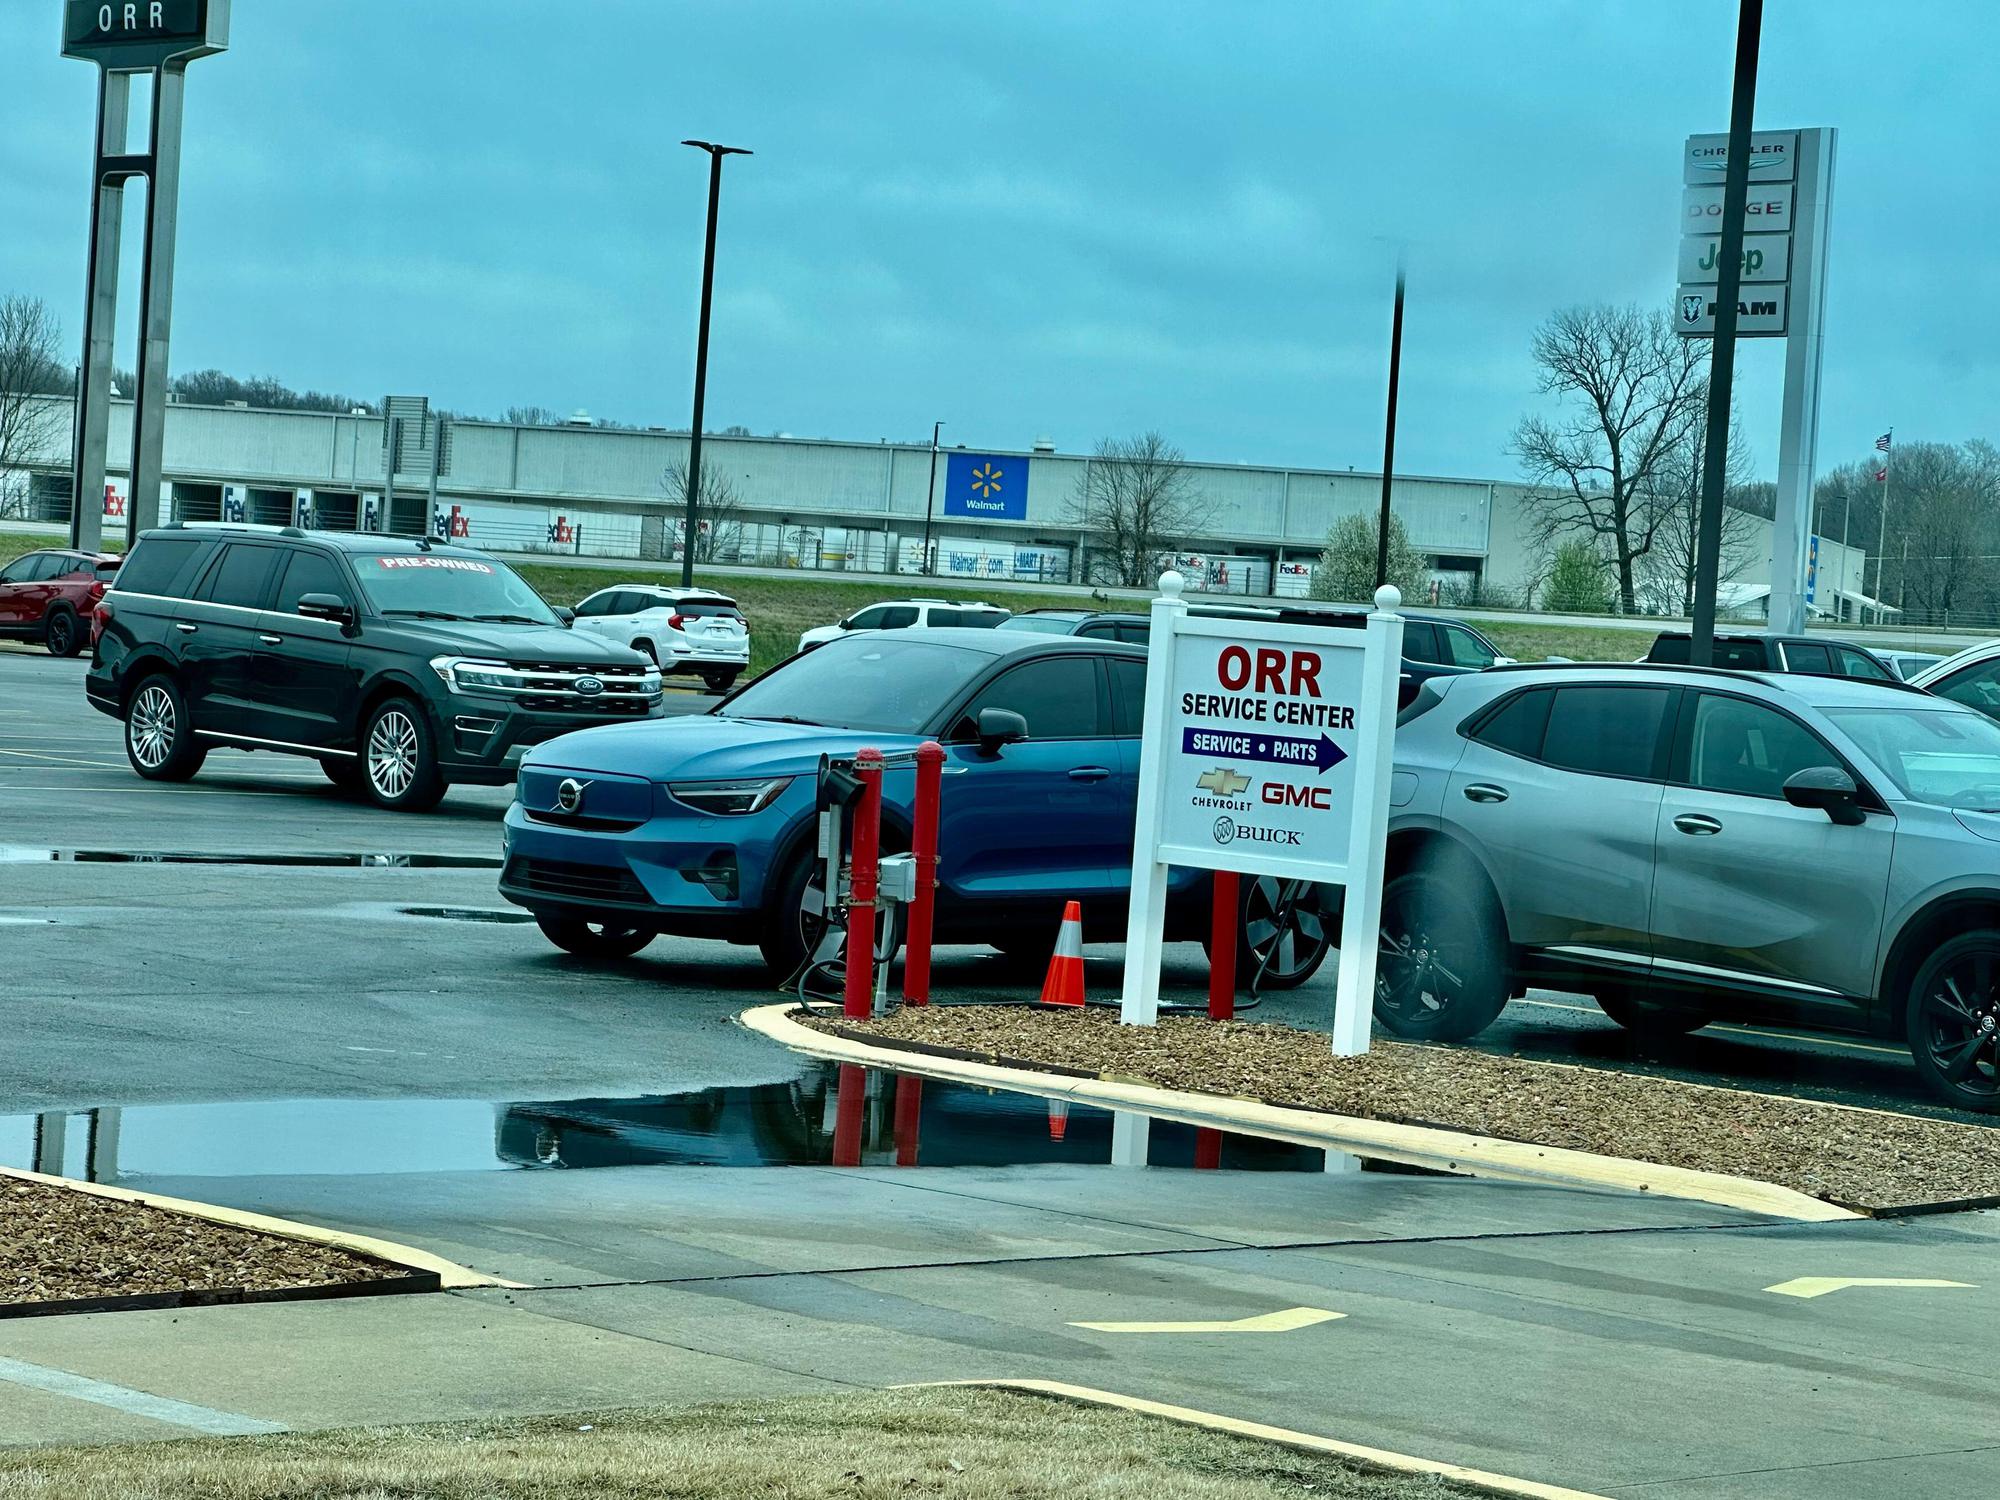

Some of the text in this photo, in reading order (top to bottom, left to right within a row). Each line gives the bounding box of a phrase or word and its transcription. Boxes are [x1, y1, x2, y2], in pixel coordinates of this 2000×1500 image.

[99, 1, 162, 32] ORR
[1692, 145, 1784, 157] CHRLER
[1689, 201, 1783, 217] DOGE
[1698, 243, 1763, 275] Jp
[966, 499, 1005, 511] Walmart
[381, 558, 492, 574] PRE-OWNED
[1279, 563, 1308, 576] FedEx
[1217, 645, 1322, 698] ORR
[1181, 692, 1355, 730] SERVICE CENTER
[1192, 733, 1317, 761] SERVICE PARTS
[1191, 796, 1252, 812] CHEVROLET
[1261, 782, 1332, 810] GMC
[1236, 825, 1301, 846] BUICK
